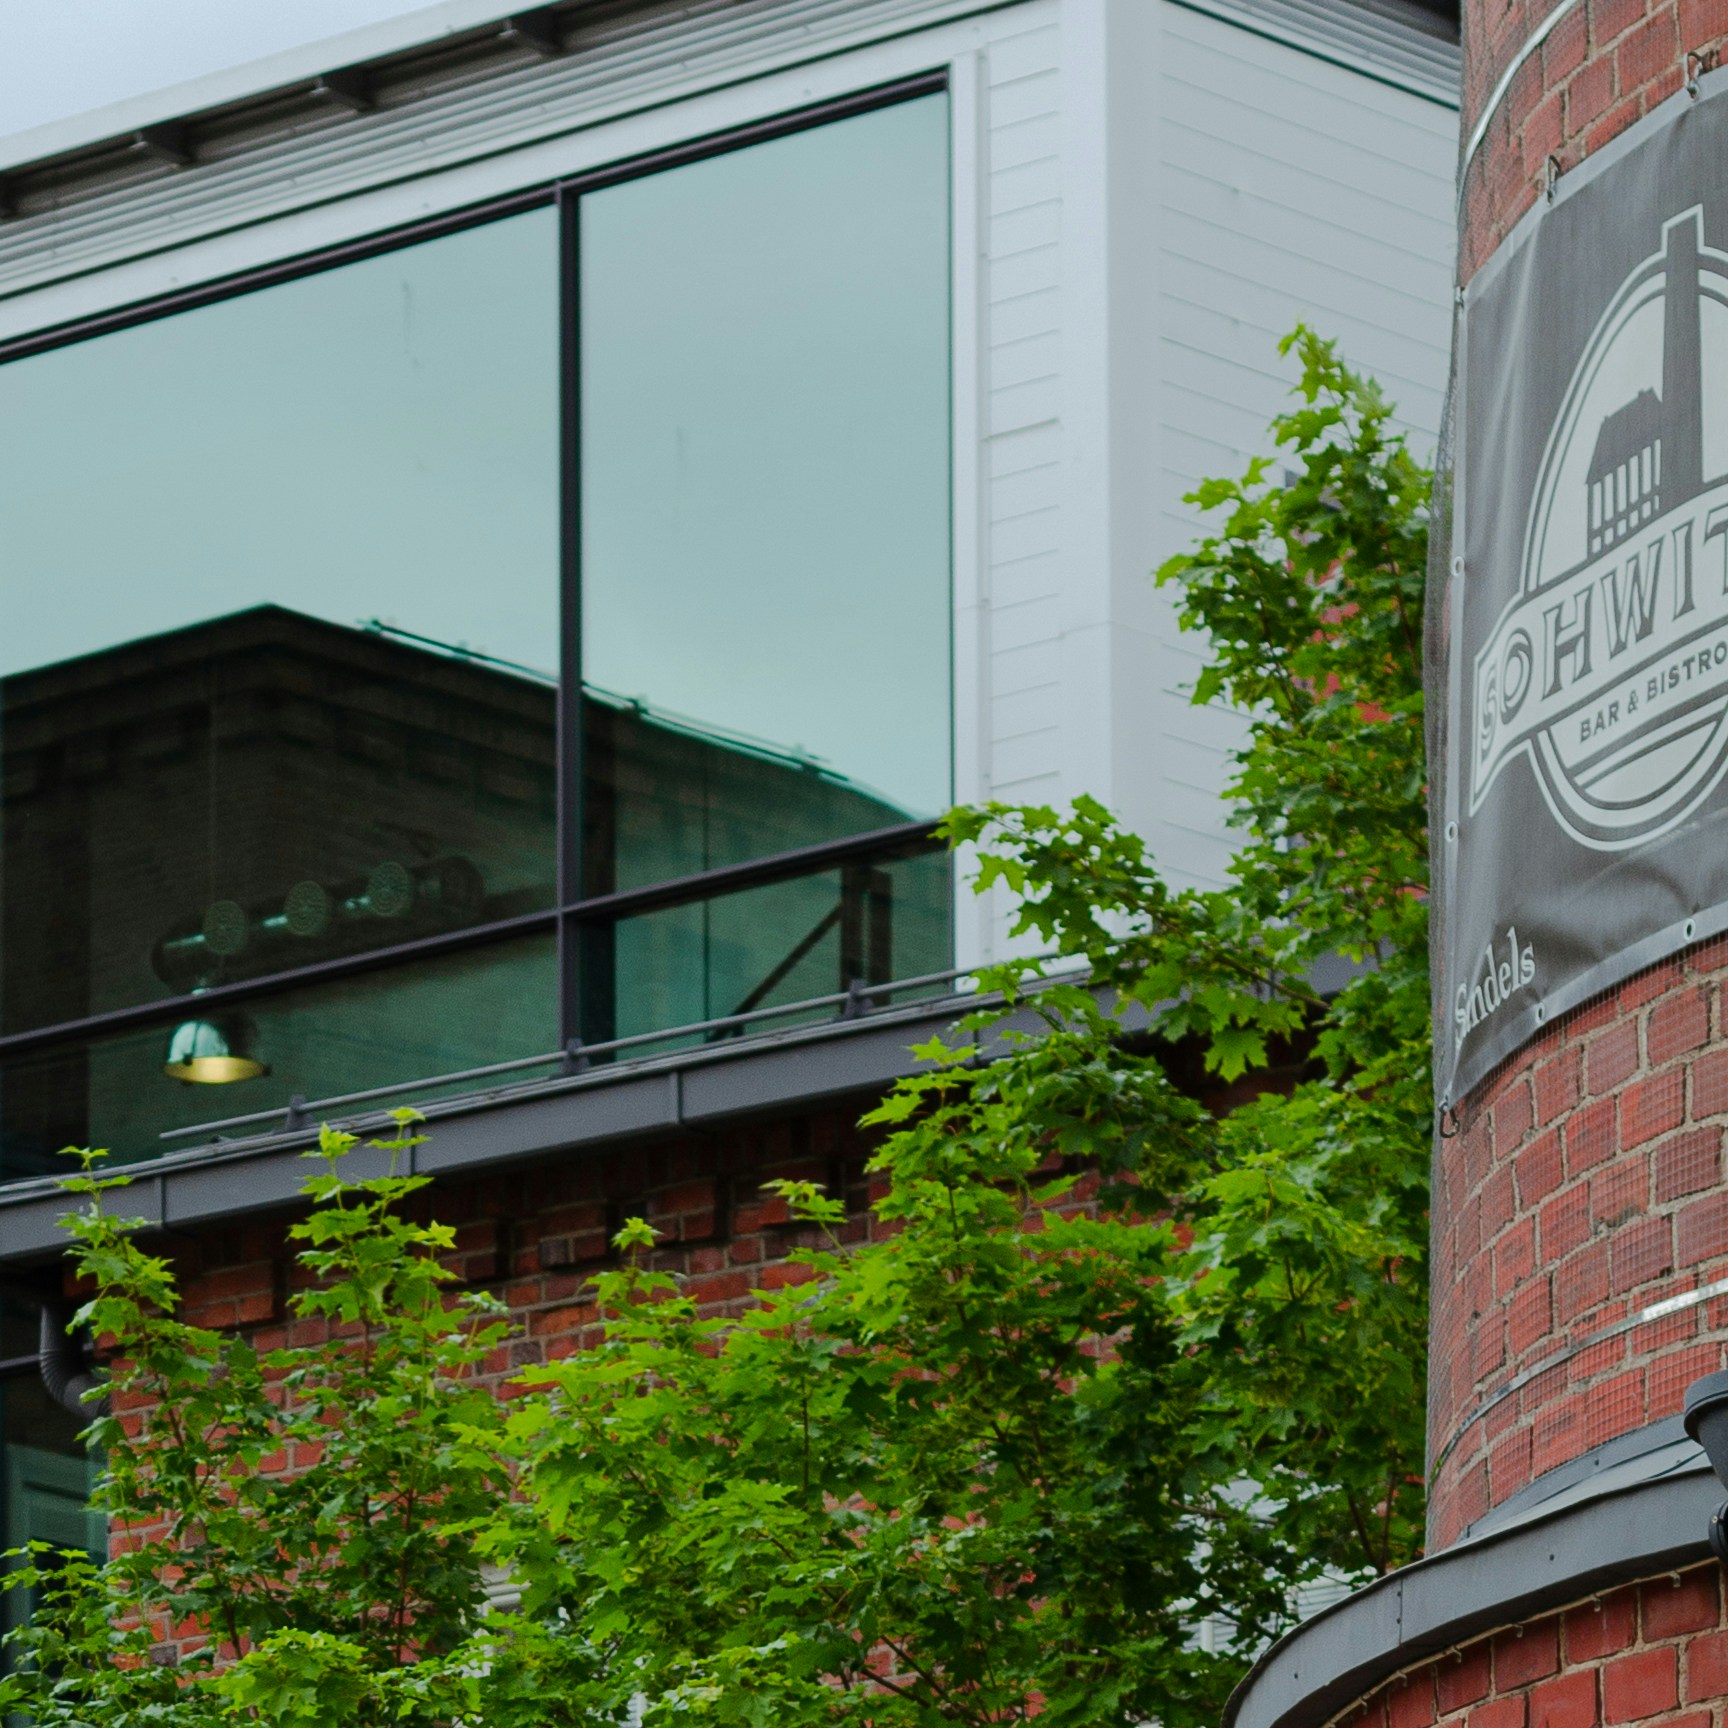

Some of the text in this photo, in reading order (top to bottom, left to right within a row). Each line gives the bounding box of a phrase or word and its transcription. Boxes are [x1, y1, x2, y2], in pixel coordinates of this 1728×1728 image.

[1580, 641, 1728, 743] BAR & BISTRO
